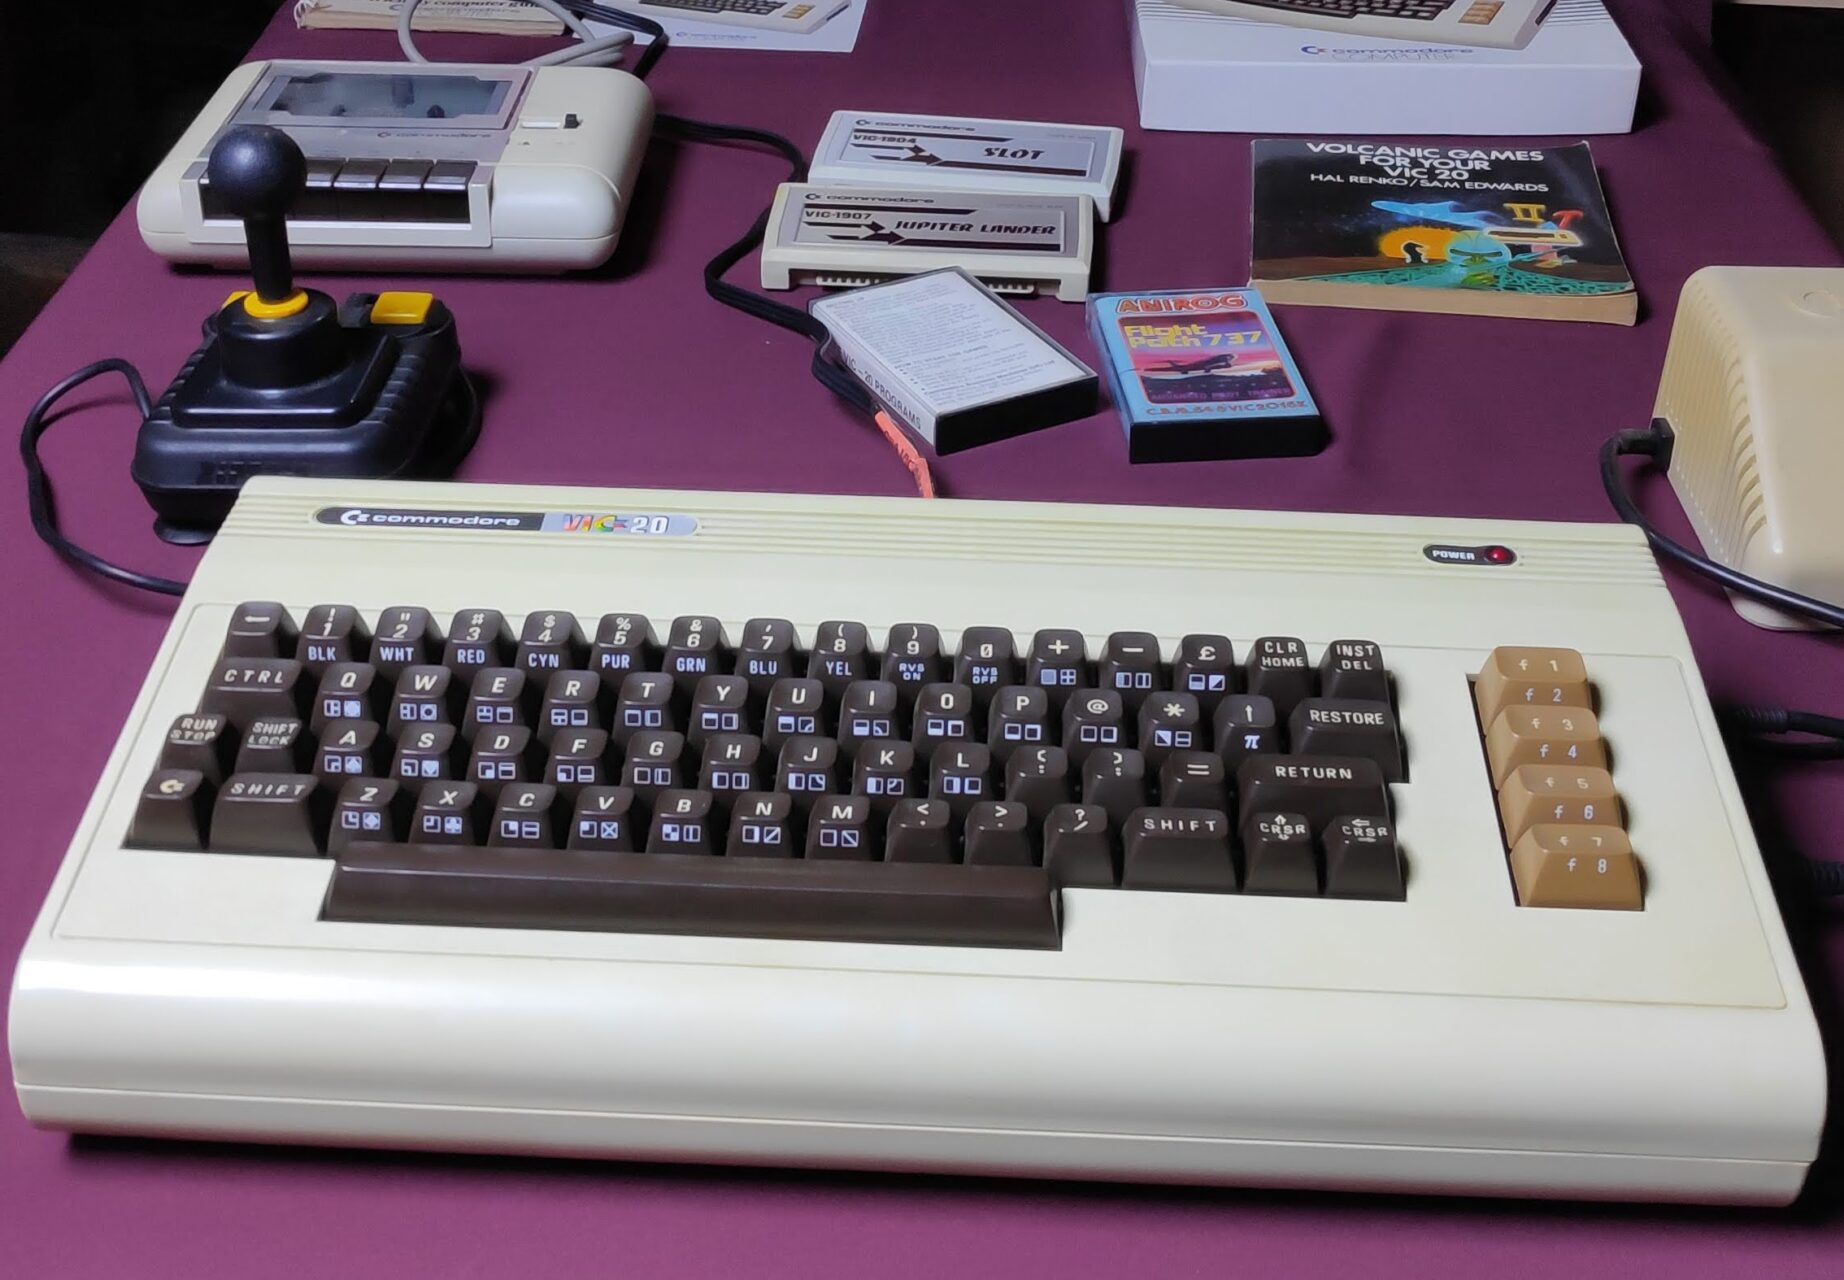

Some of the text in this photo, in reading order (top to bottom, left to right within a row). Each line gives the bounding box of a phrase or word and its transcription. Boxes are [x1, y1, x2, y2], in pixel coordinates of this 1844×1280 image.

[1332, 47, 1474, 55] commodore
[874, 121, 977, 133] commodore
[983, 146, 1046, 161] SLOT
[1306, 142, 1545, 162] VOLCANIC GAMES
[1359, 154, 1492, 171] FOR YOUR
[1383, 166, 1470, 180] VIC 20
[1310, 173, 1345, 183] HAL
[1464, 181, 1550, 193] EDWARDS
[826, 194, 936, 205] commodore
[804, 210, 873, 221] VIC-1907
[894, 219, 1057, 236] JUPITER LANDER
[1117, 294, 1247, 313] ANIROG
[1123, 323, 1206, 338] Flight
[1129, 330, 1262, 348] Path 737
[874, 379, 922, 430] PROGRAMS
[371, 514, 521, 526] commodore
[1431, 549, 1476, 561] POWER
[322, 622, 332, 638] 1
[392, 624, 408, 638] 2
[466, 626, 482, 642] 3
[538, 628, 552, 642] 4
[612, 632, 628, 646] 5
[686, 634, 700, 648] 6
[762, 636, 774, 650] 7
[834, 638, 846, 652] 8
[906, 640, 920, 654] 9
[1264, 640, 1298, 654] CLR
[308, 646, 336, 662] BLK
[380, 646, 414, 662] WHT
[456, 648, 486, 664] RED
[1336, 644, 1376, 658] INST
[528, 652, 560, 668] CYN
[602, 654, 630, 670] PUR
[676, 656, 706, 672] GRN
[750, 660, 778, 676] BLU
[826, 660, 852, 676] YEL
[1262, 656, 1304, 668] HOME
[1342, 658, 1372, 670] DEL
[224, 668, 284, 684] CTRL
[340, 672, 356, 688] Q
[414, 674, 438, 690] W
[902, 672, 922, 680] ON
[972, 674, 998, 684] OFF
[492, 676, 506, 694] E
[564, 680, 582, 696] R
[640, 682, 656, 698] T
[716, 684, 732, 702] Y
[790, 688, 806, 704] U
[868, 690, 876, 706] I
[940, 692, 954, 710] O
[1016, 694, 1030, 712] P
[180, 718, 218, 730] RUN
[1310, 708, 1386, 726] RESTORE
[170, 730, 216, 742] STOP
[252, 722, 298, 734] SHIFT
[248, 734, 292, 746] LOCK
[338, 730, 356, 746] A
[418, 732, 434, 748] S
[494, 736, 510, 750] D
[572, 738, 588, 754] F
[648, 740, 664, 756] G
[726, 744, 742, 760] H
[804, 746, 818, 762] J
[880, 750, 896, 766] K
[956, 752, 970, 768] L
[1274, 764, 1352, 780] RETURN
[230, 782, 306, 796] SHIFT
[358, 786, 378, 802] Z
[438, 790, 458, 806] X
[518, 792, 536, 808] C
[598, 796, 616, 810] V
[676, 798, 692, 814] B
[754, 802, 772, 816] N
[832, 804, 852, 820] M
[1144, 818, 1216, 832] SHIFT
[1258, 822, 1306, 836] CRSR
[1342, 824, 1388, 838] CRSR
